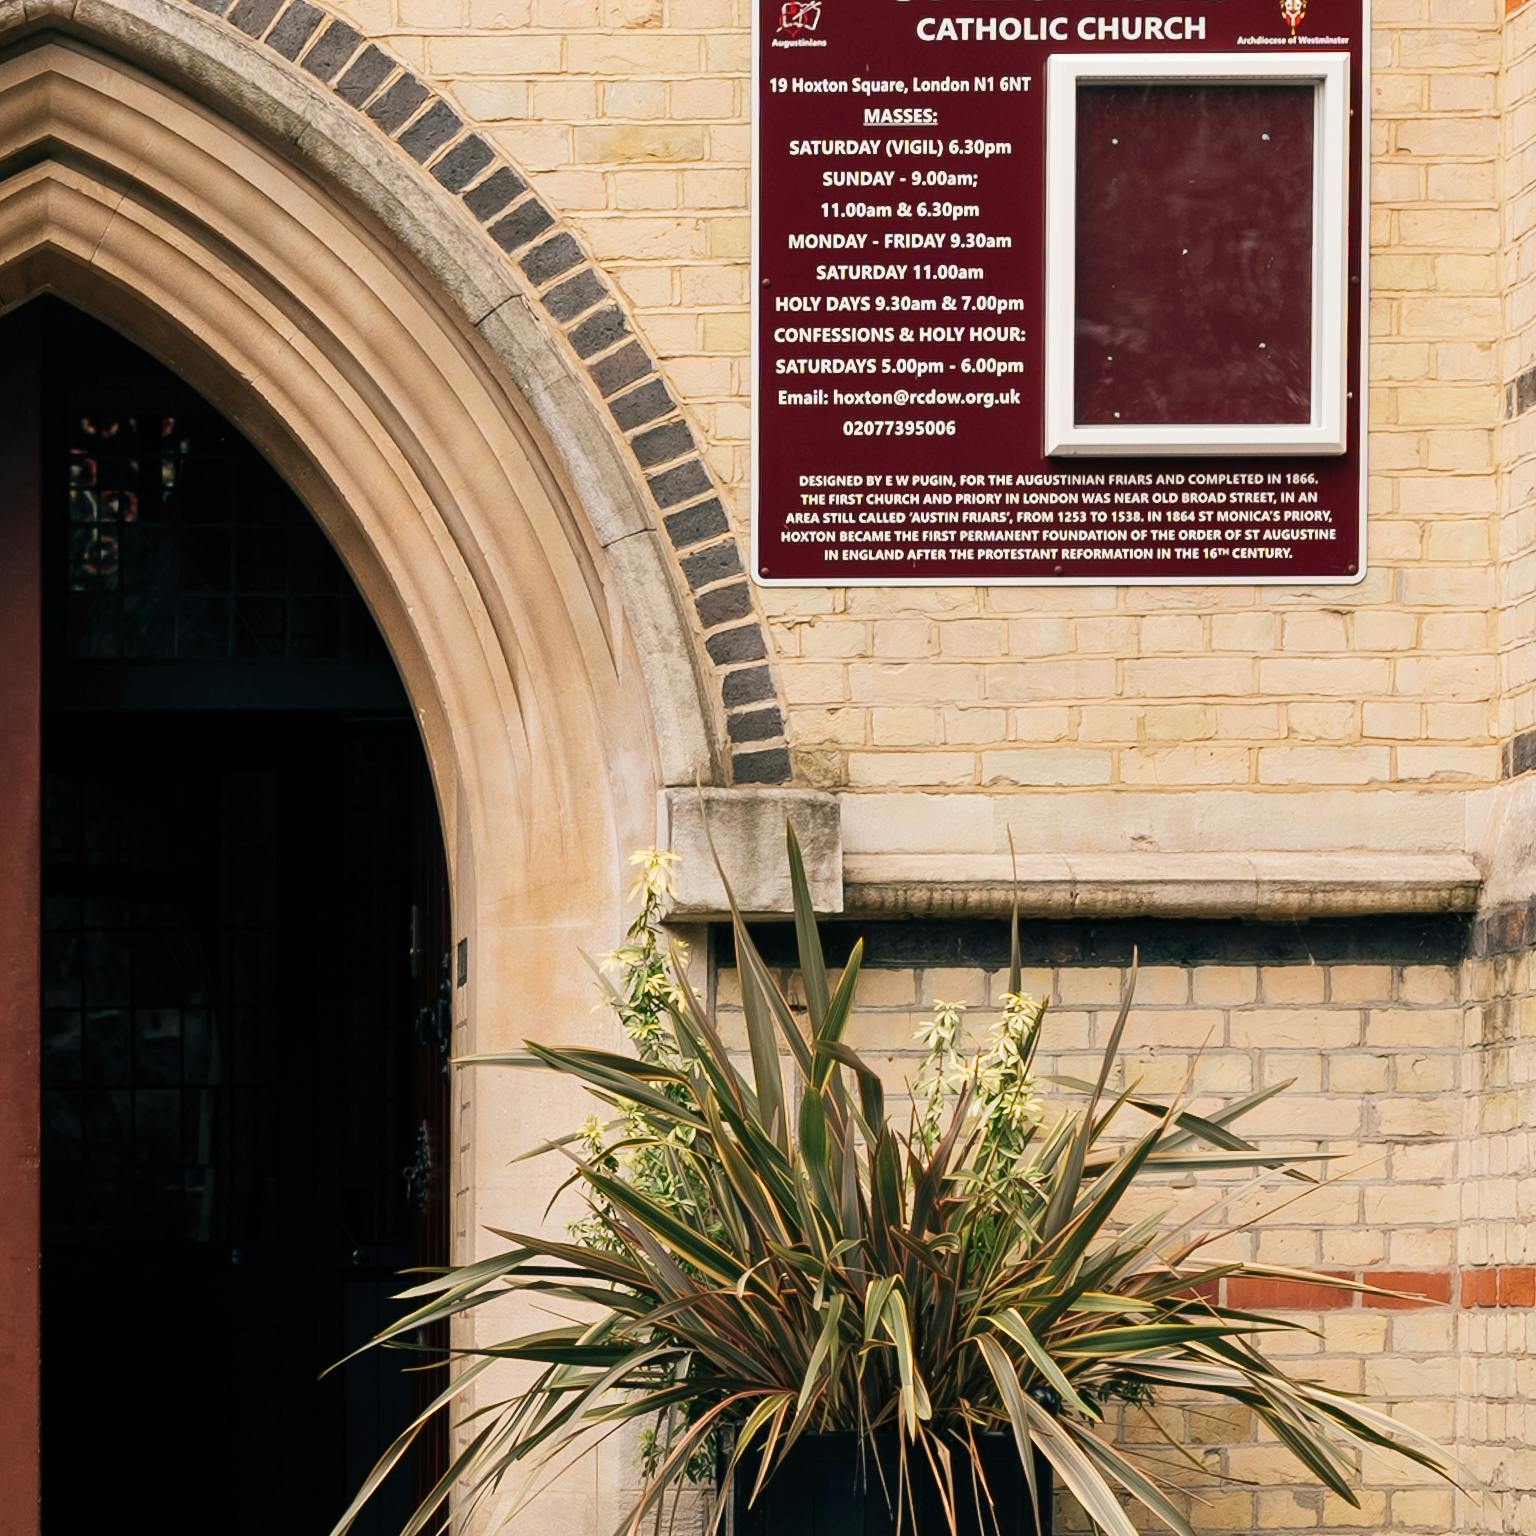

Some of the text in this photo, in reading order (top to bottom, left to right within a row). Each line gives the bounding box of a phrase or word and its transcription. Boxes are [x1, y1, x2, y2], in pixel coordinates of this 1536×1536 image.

[916, 16, 1206, 41] CATHOLIC CHURCH
[772, 38, 827, 48] Augustinians
[1237, 36, 1349, 45] Archdiocese of Westminster
[770, 76, 1032, 96] 19 Hoxton Square, London N1 6NT
[863, 108, 938, 126] MASSES:
[789, 139, 1012, 158] SATURDAY (VIGIL) 6.30pm
[822, 171, 895, 186] SUNDAY
[911, 170, 978, 188] 9.00am;
[821, 202, 980, 221] 11.00am & 6.30pm
[788, 234, 868, 249] MONDAY
[884, 233, 946, 248] FRIDAY
[950, 233, 1012, 248] 9.30am
[816, 264, 984, 280] SATURDAY 11.00am
[776, 296, 1024, 314] HOLY DAYS 9.30am & 7.00pm
[774, 326, 1026, 343] CONFESSIONS & HOLY HOUR:
[776, 358, 877, 374] SATURDAYS
[882, 358, 944, 377] 5.00pm
[960, 358, 1024, 377] 6.00pm
[778, 388, 1020, 408] Email: hoxton@rcdow.org.uk
[843, 420, 956, 436] 02077395006
[799, 473, 1318, 488] DESIGNED BY E W PUGIN, FOR THE AUGUSTINIAN FRIARS AND COMPLETED IN 1866.
[800, 492, 1318, 505] THE FIRST CHURCH AND PRIORY IN LONDON WAS NEAR OLD BROAD STREET, IN AN
[786, 512, 820, 524] AREA
[822, 512, 856, 524] STILL
[858, 512, 906, 524] CALLED
[1016, 512, 1054, 522] FROM
[1058, 511, 1087, 522] 1253
[1090, 511, 1108, 522] TO
[1111, 511, 1144, 522] 1538.
[1148, 511, 1162, 522] IN
[1166, 511, 1196, 522] 1864
[1198, 510, 1214, 522] ST
[1284, 510, 1332, 523] PRIORY,
[781, 528, 1336, 542] HOXTON BECAME THE FIRST PERMANENT FOUNDATION OF THE ORDER OF ST AUGUSTINE
[824, 550, 838, 560] IN
[842, 549, 904, 560] ENGLAND
[907, 549, 946, 560] AFTER
[949, 548, 974, 560] THE
[977, 548, 1058, 560] PROTESTANT
[1061, 548, 1153, 560] REFORMATION
[1157, 548, 1171, 559] IN
[1174, 548, 1199, 559] THE
[1232, 548, 1293, 559] CENTURY.
